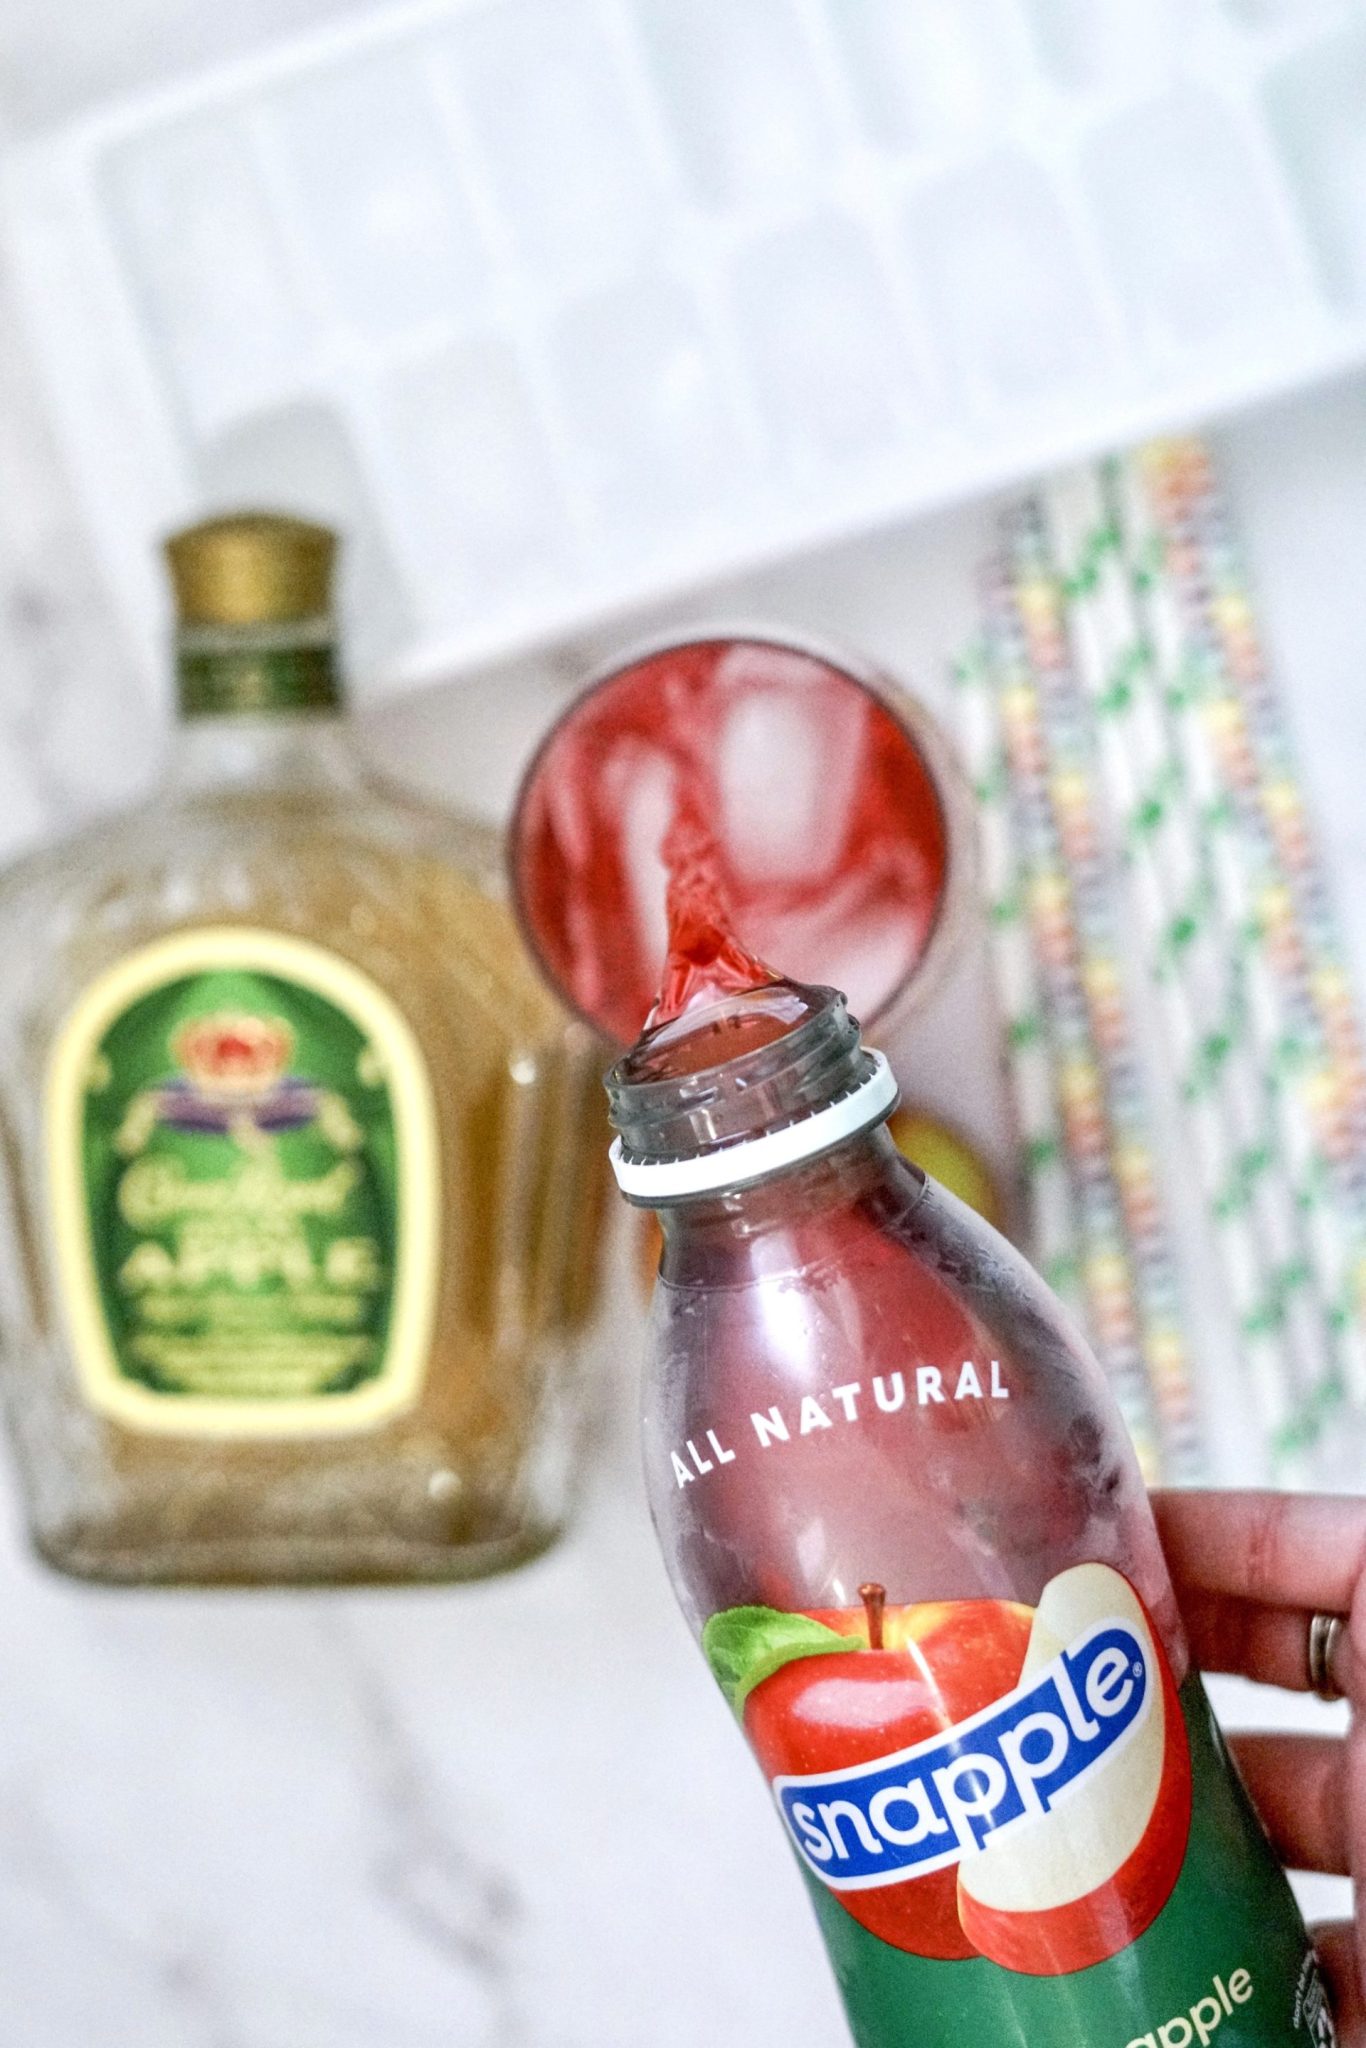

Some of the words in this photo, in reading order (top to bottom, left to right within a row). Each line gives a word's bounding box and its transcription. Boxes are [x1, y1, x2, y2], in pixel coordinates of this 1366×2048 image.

[670, 1429, 736, 1489] ALL
[750, 1360, 1010, 1448] NATURAL
[791, 1647, 1135, 1861] snapple
